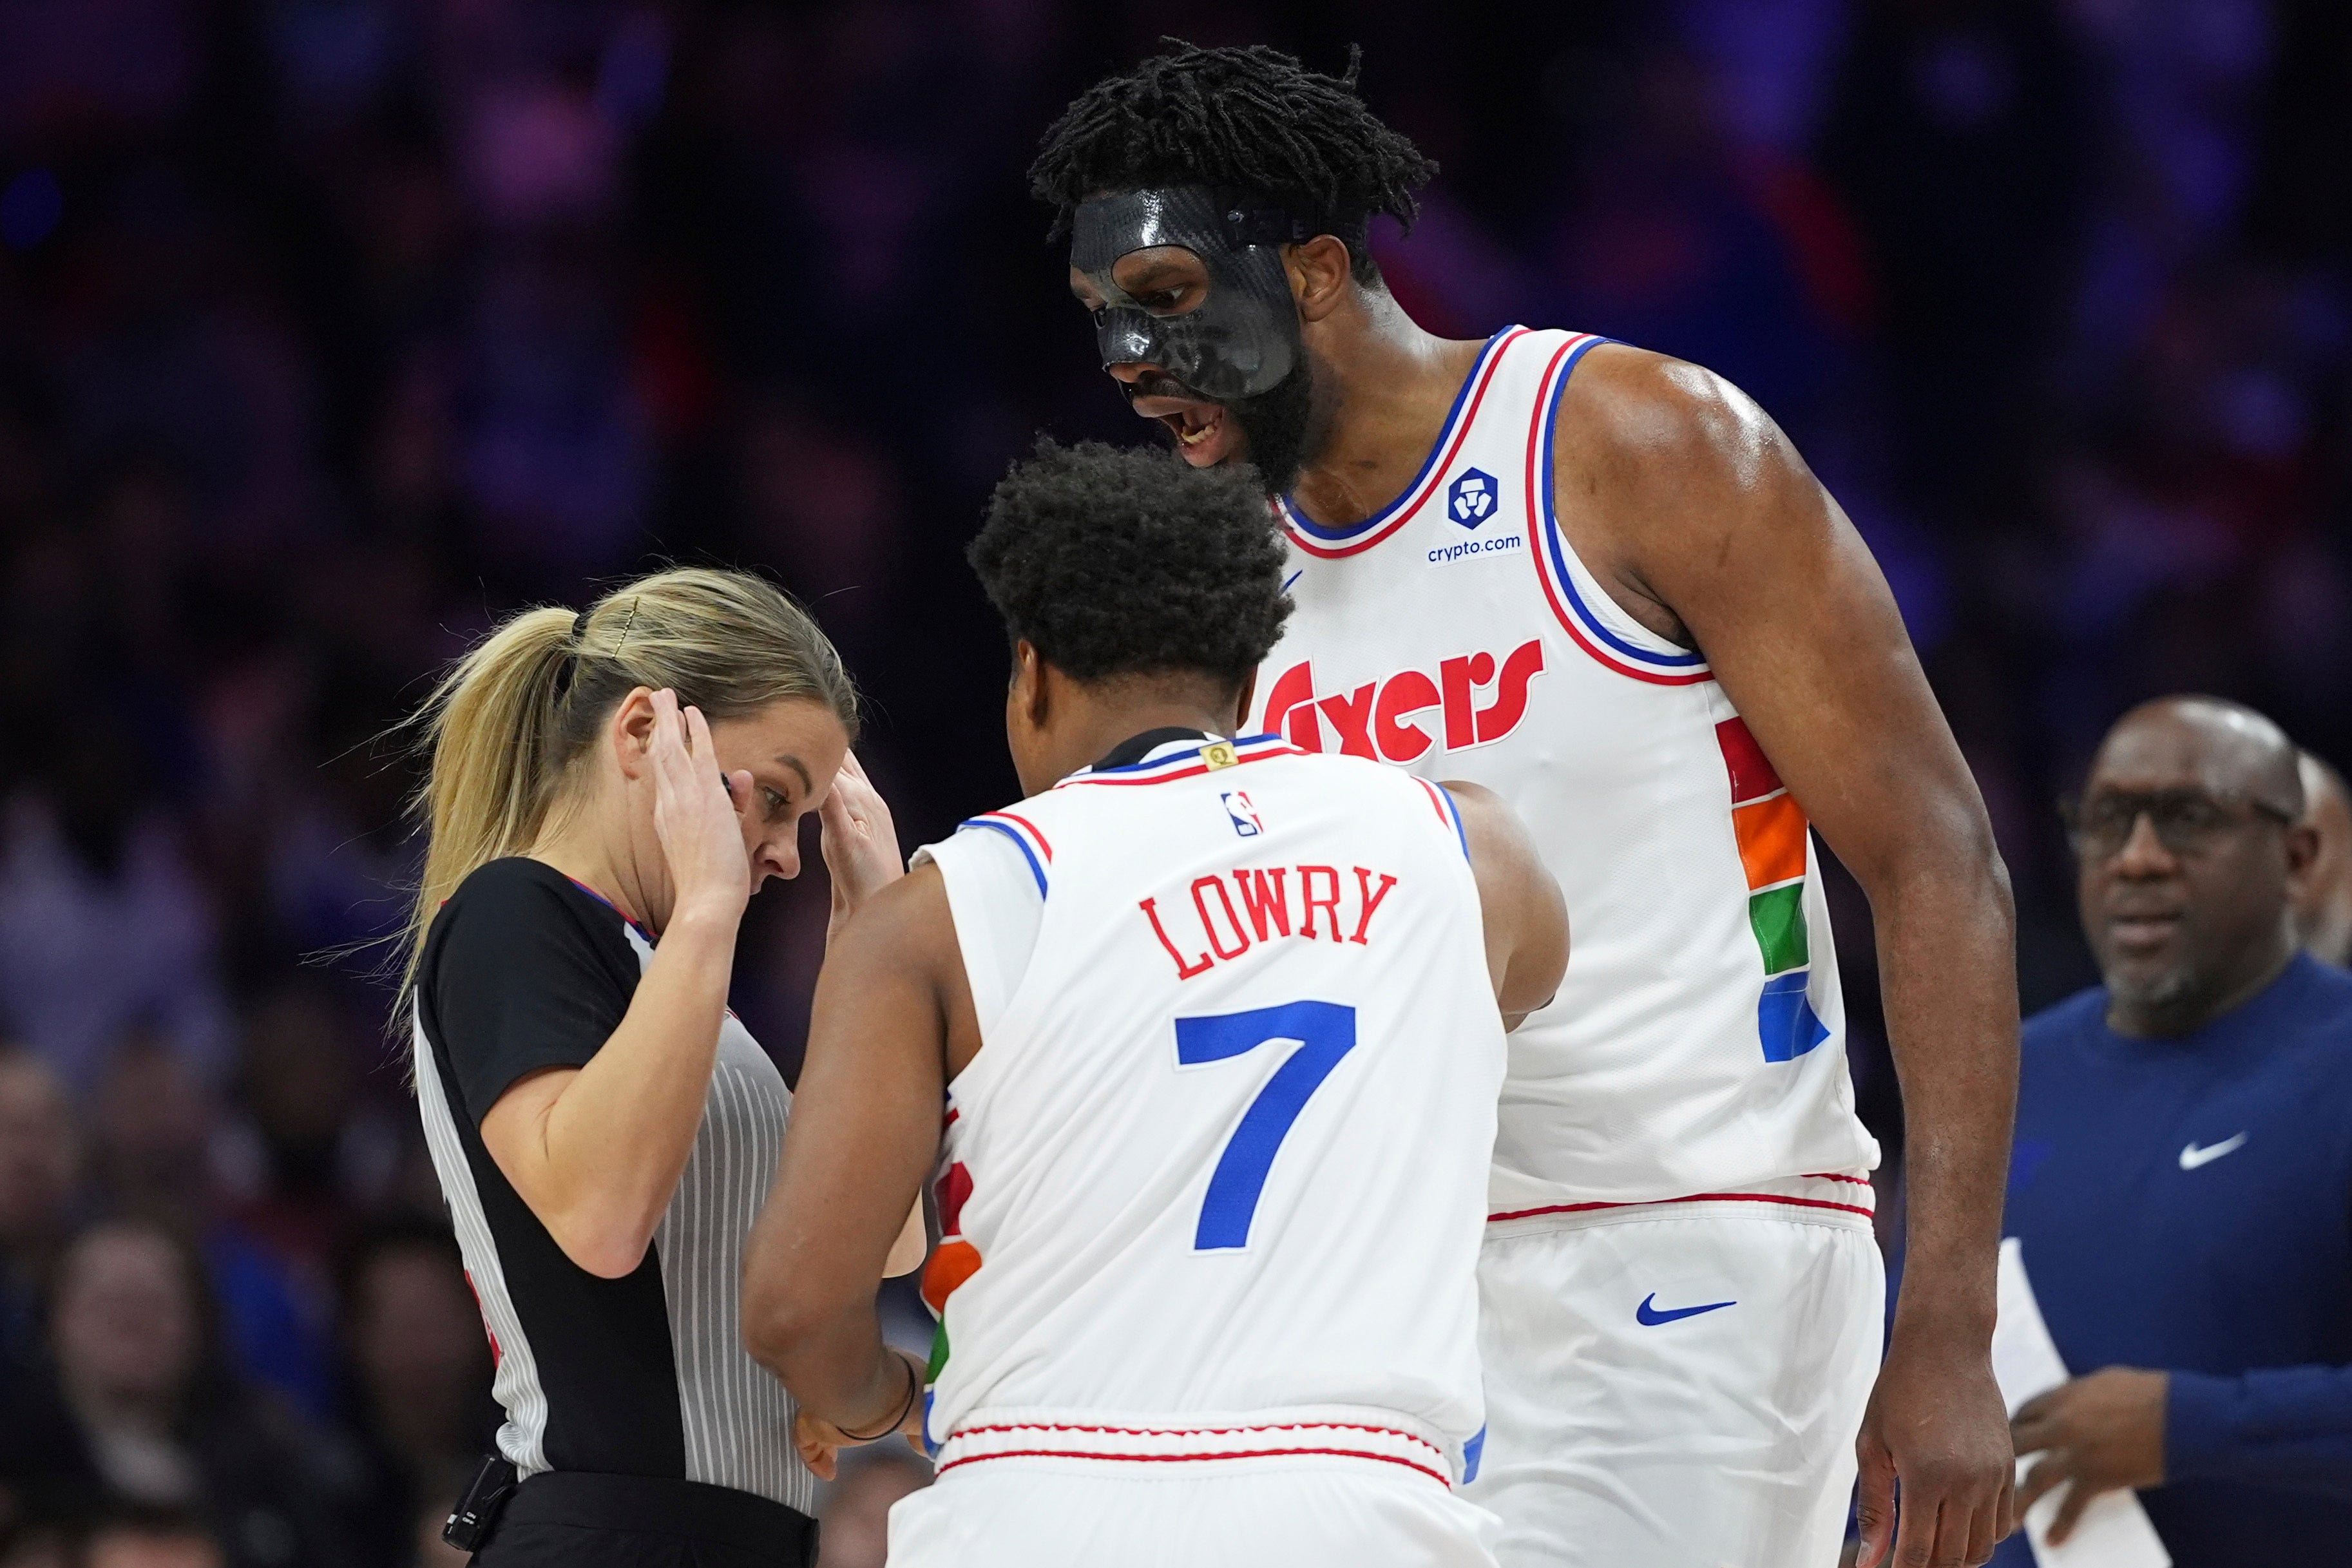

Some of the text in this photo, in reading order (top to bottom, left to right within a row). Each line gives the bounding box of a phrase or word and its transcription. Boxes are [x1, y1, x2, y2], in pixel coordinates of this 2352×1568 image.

[1428, 536, 1520, 562] crypto.com
[1140, 865, 1397, 980] LOWRY
[1174, 999, 1356, 1251] 7
